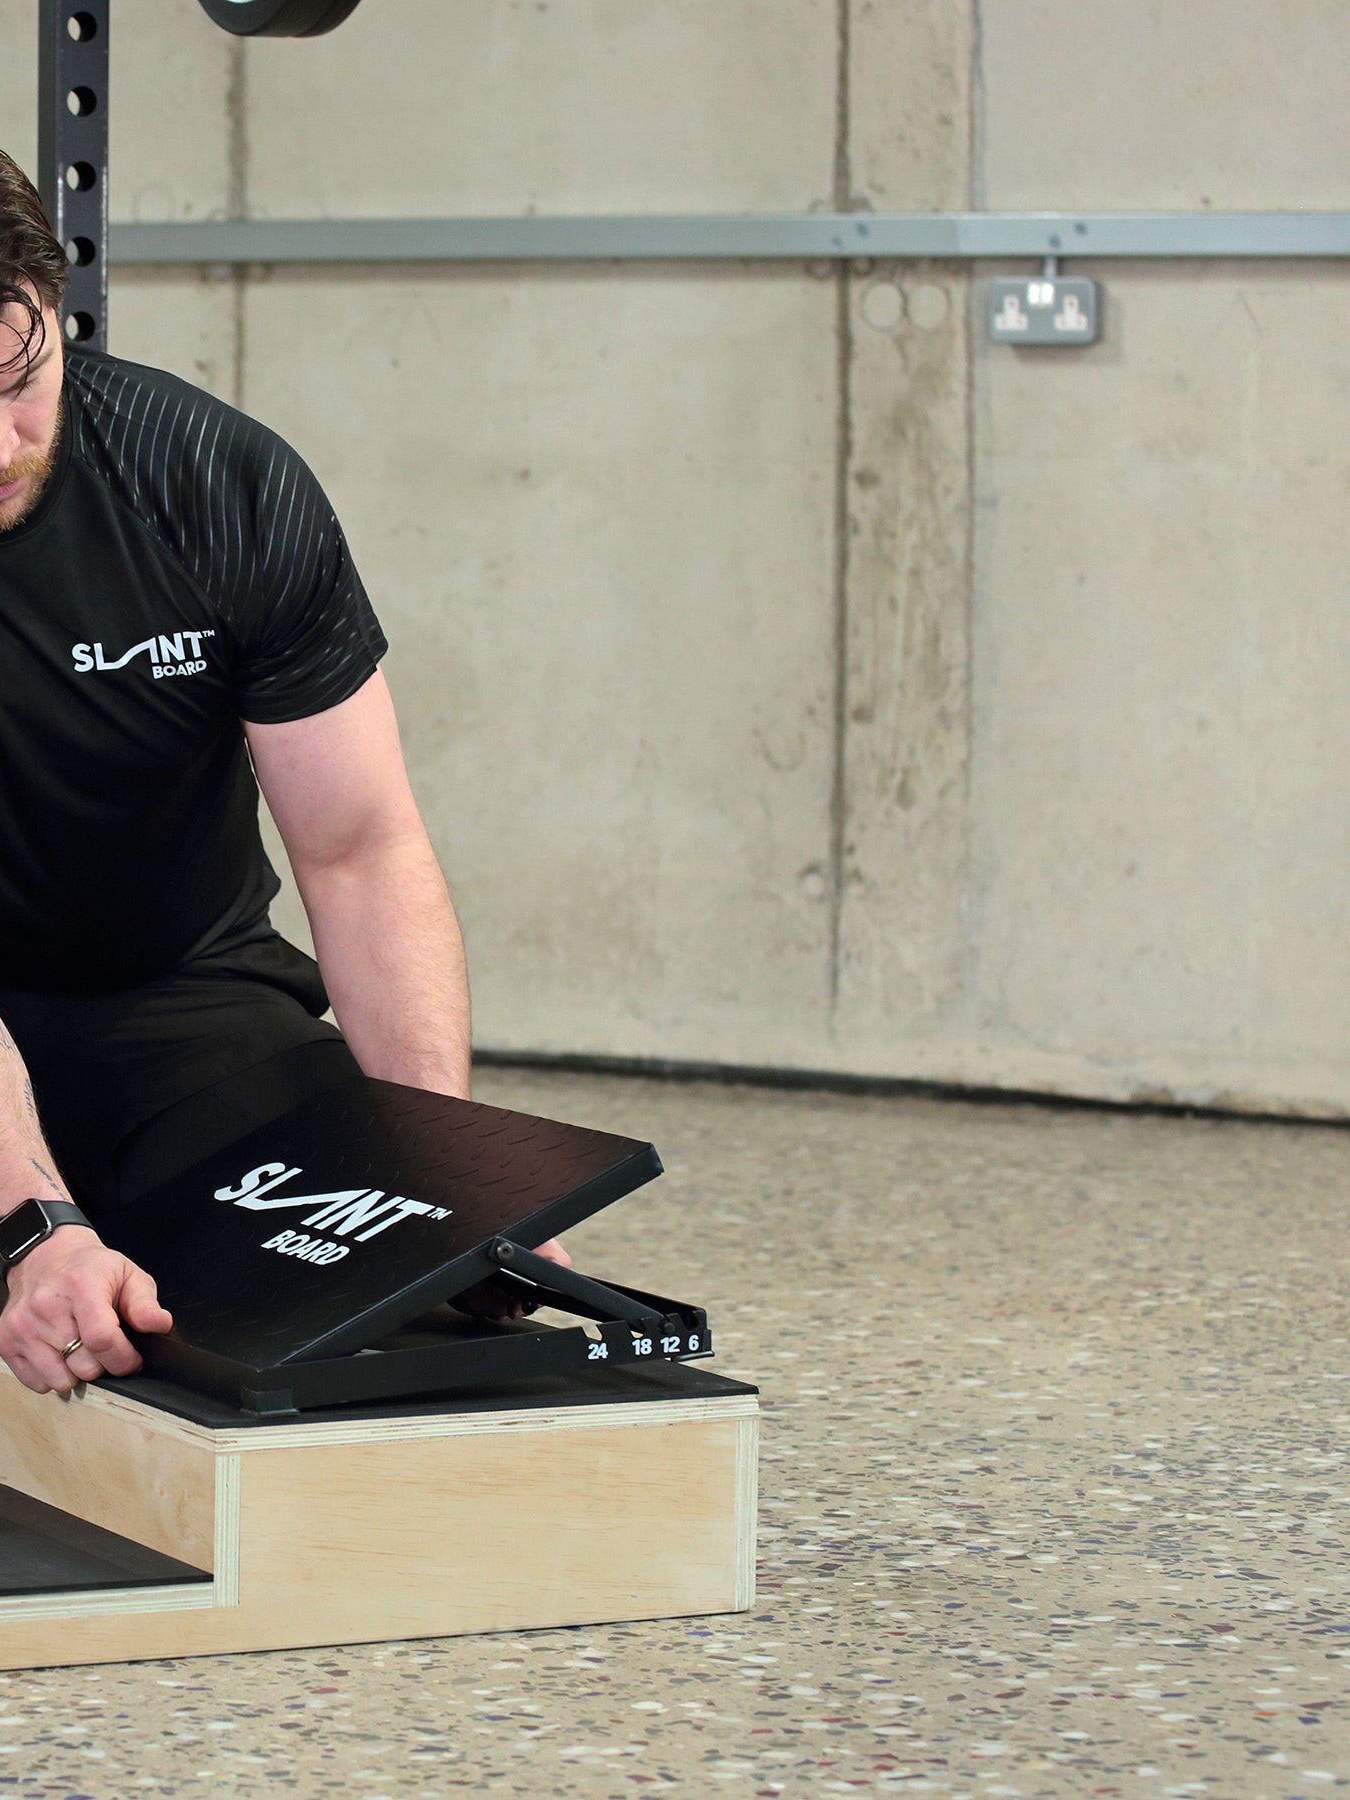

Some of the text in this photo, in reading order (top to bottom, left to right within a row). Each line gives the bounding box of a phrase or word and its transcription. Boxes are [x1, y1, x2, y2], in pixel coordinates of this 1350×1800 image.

[152, 659, 207, 680] BOARD
[260, 1229, 351, 1266] BOARD
[587, 1334, 700, 1360] 24 18 12 6
